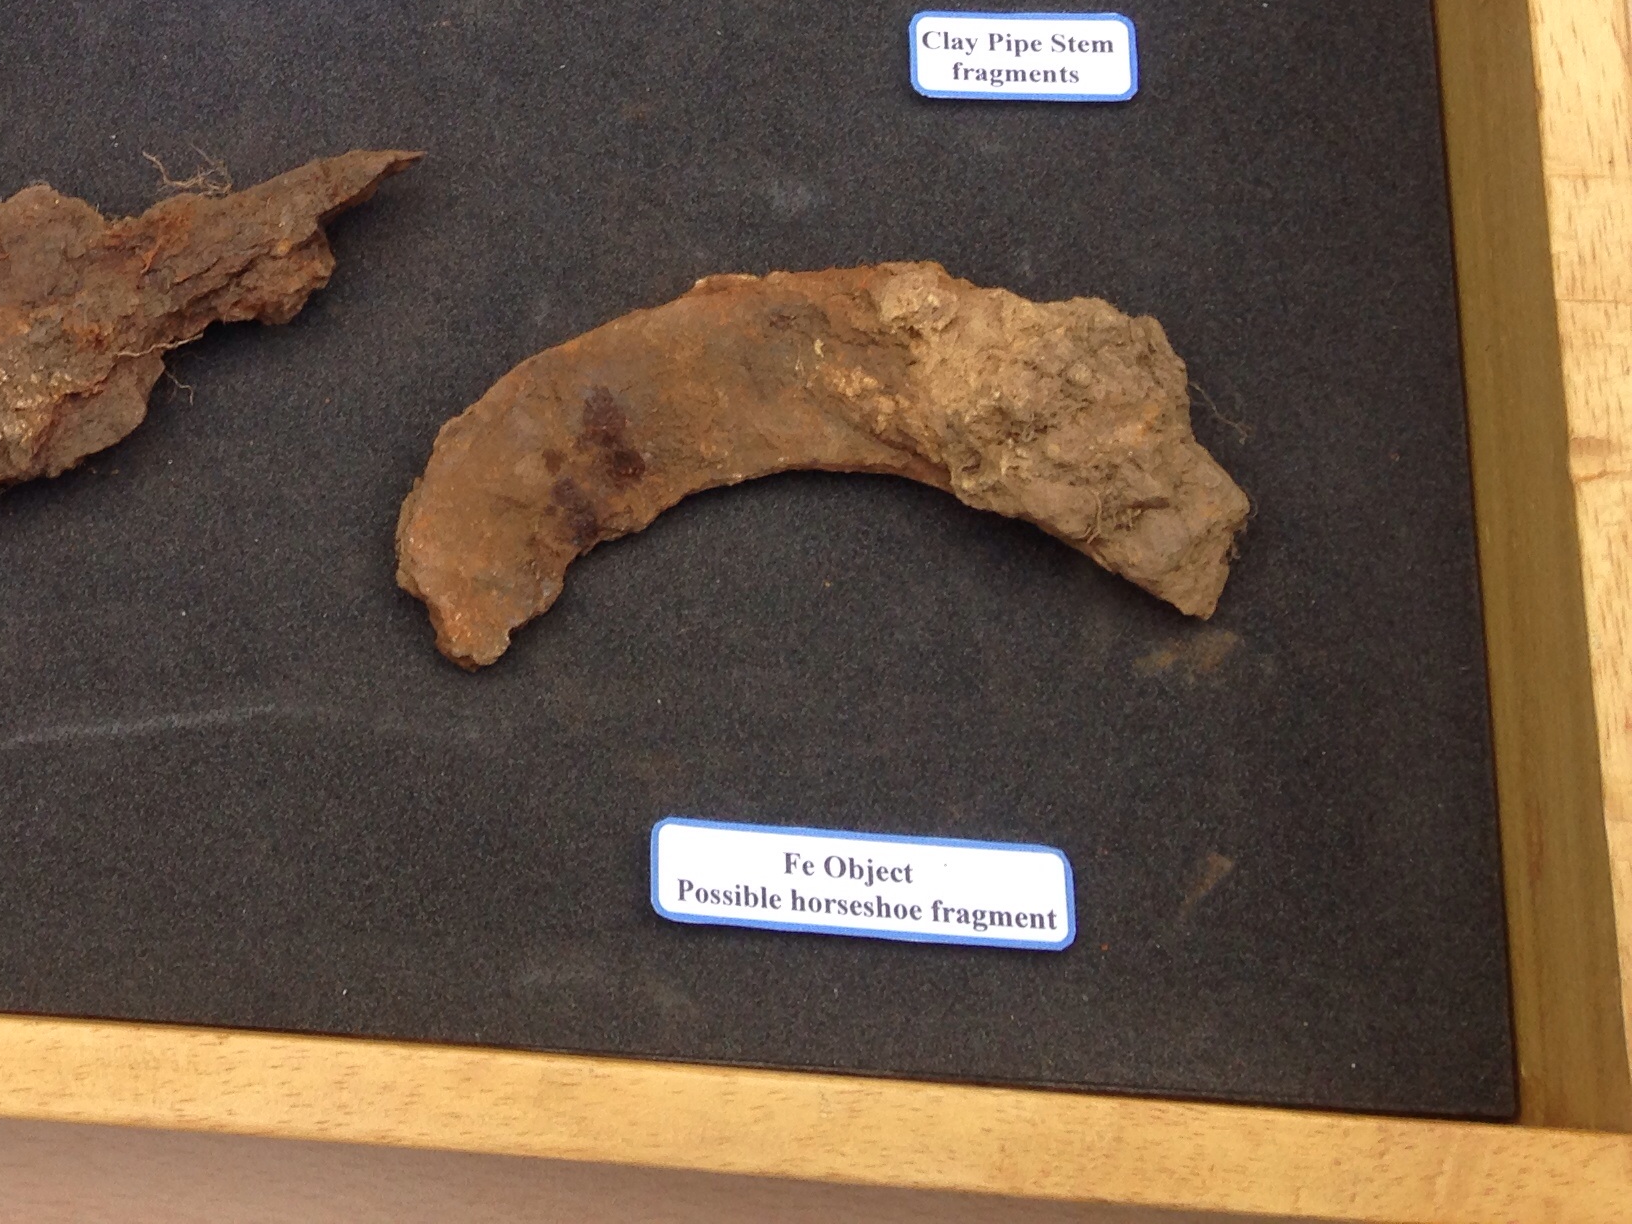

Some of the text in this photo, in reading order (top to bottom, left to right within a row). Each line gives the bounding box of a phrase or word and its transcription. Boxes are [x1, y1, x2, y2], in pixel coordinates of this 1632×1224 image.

[922, 31, 1113, 57] Clay Pipe Stem
[953, 62, 1079, 86] fragments
[785, 852, 912, 887] Fe Object
[678, 879, 1057, 933] Possible horseshoe fragment
